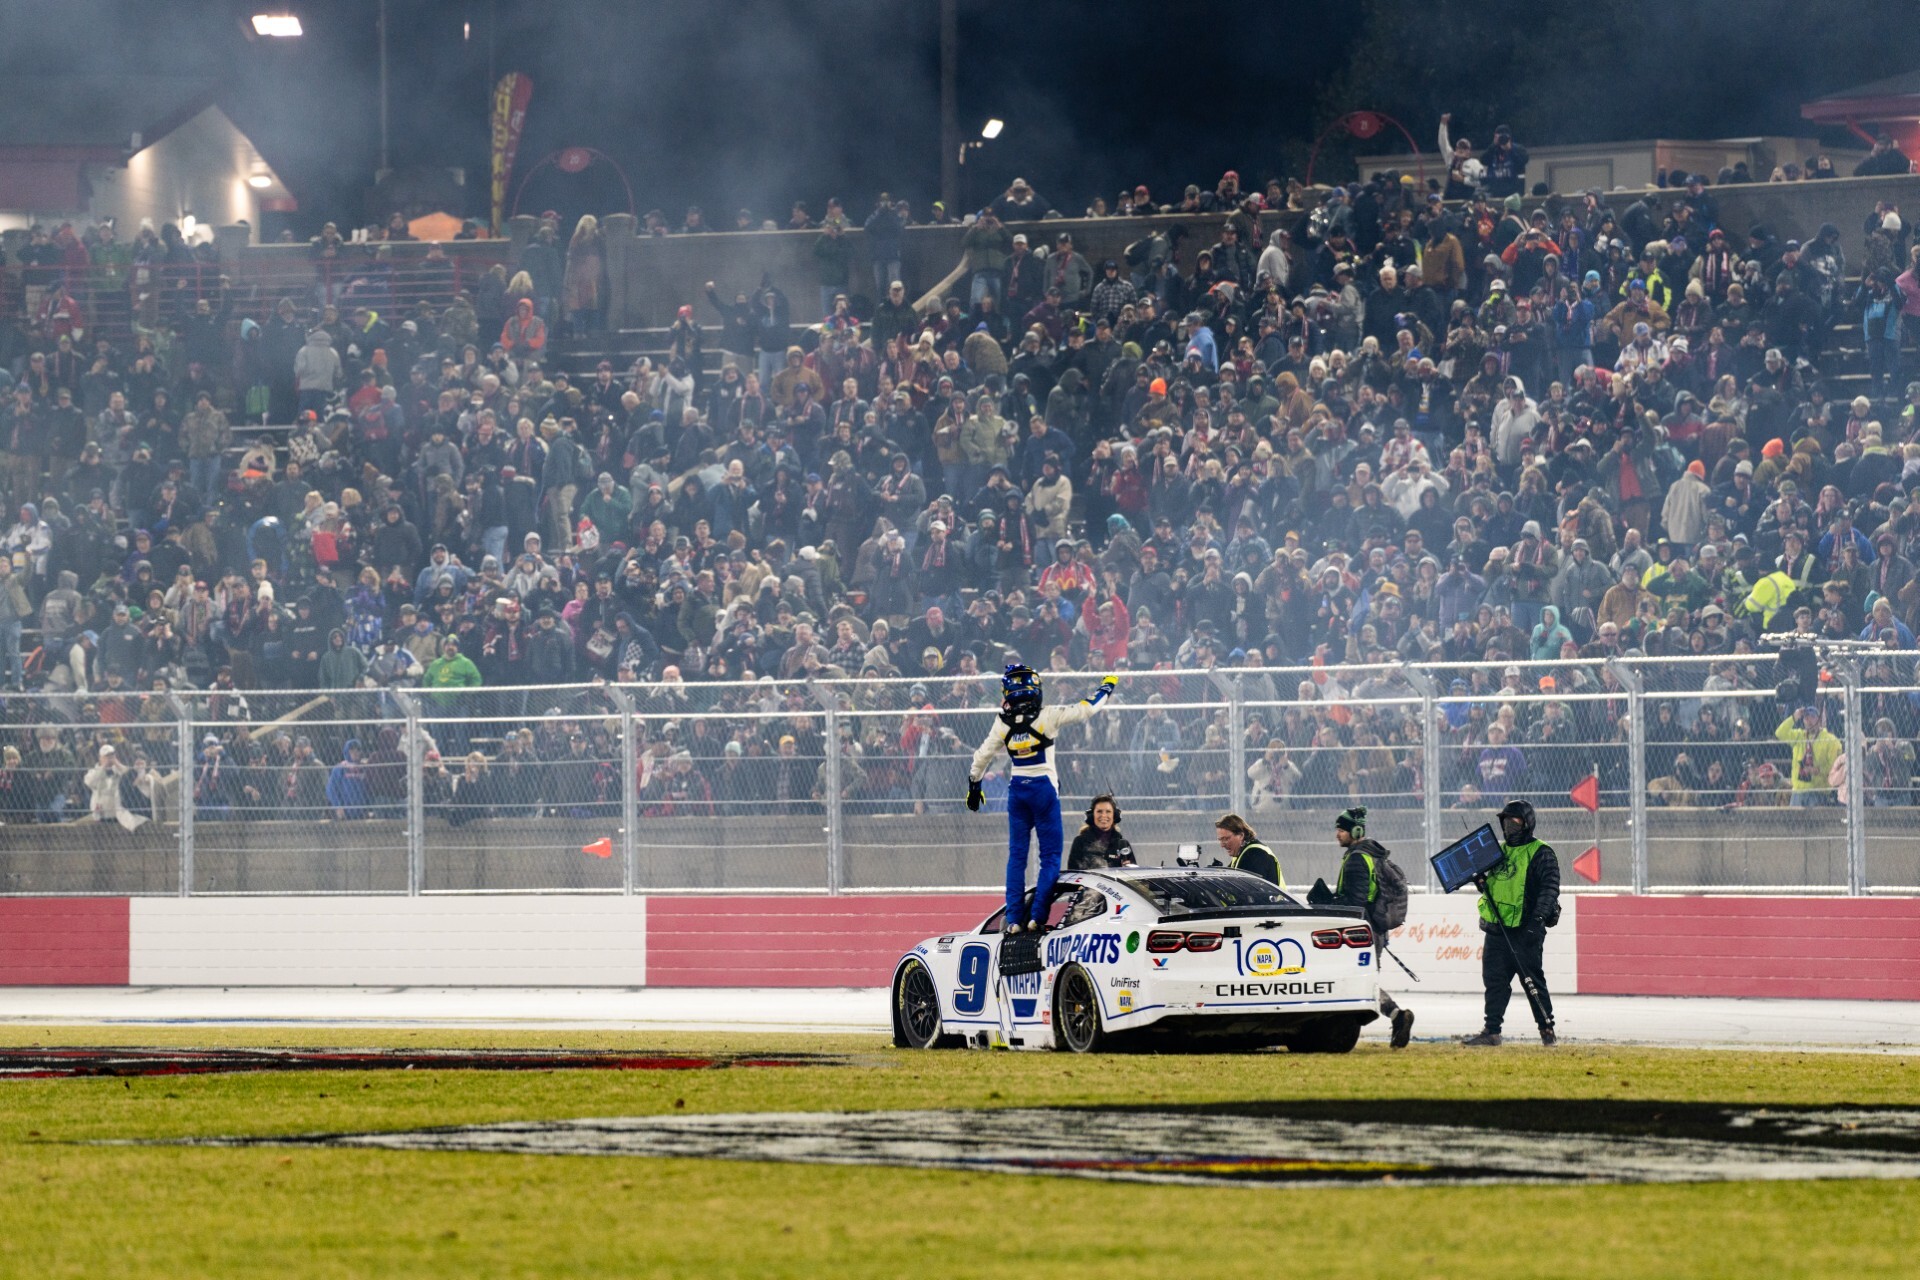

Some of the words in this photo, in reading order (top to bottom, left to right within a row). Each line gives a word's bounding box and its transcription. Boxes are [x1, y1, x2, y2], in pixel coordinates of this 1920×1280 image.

[1068, 933, 1122, 964] PARTS
[1435, 945, 1473, 961] come
[1232, 938, 1305, 976] 100
[1257, 954, 1272, 964] NAPA
[1357, 951, 1371, 967] 9
[953, 942, 990, 1016] 9
[1012, 971, 1038, 994] NAPA
[1110, 977, 1140, 988] UniFirst
[1215, 981, 1335, 997] CHEVROLET
[1119, 996, 1132, 1007] NAPA
